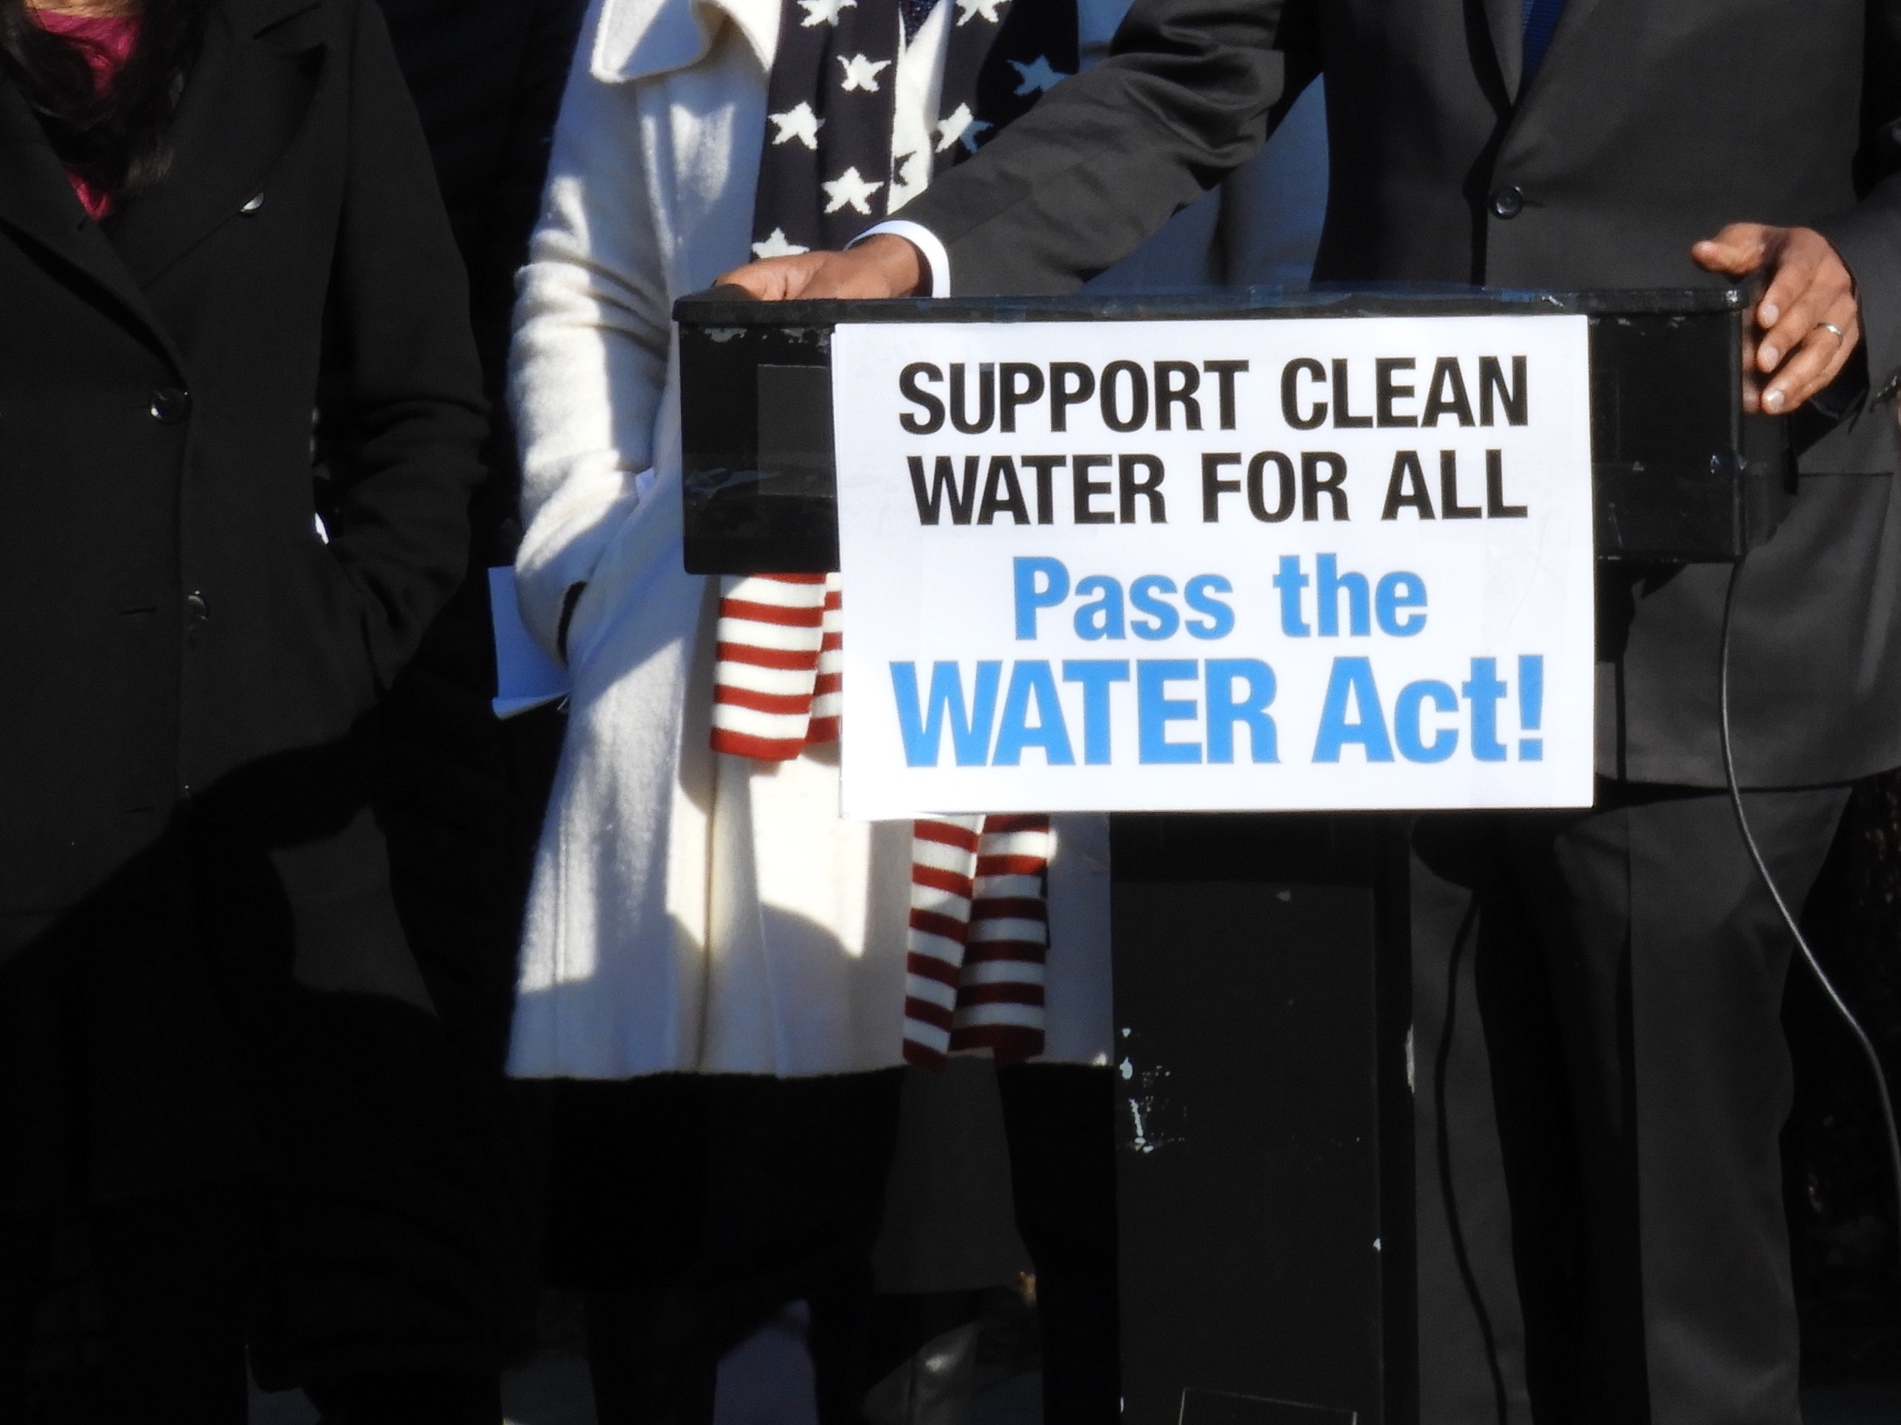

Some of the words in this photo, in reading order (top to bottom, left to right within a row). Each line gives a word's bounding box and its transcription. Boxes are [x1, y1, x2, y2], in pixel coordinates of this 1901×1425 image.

[899, 359, 1250, 436] SUPPORT
[1281, 356, 1529, 431] CLEAN
[907, 453, 1167, 526] WATER
[1202, 450, 1350, 524] FOR
[1382, 449, 1529, 521] ALL
[1013, 556, 1236, 641] Pass
[1273, 553, 1429, 638] the
[890, 658, 1281, 768] WATER
[1313, 654, 1545, 765] Act!
